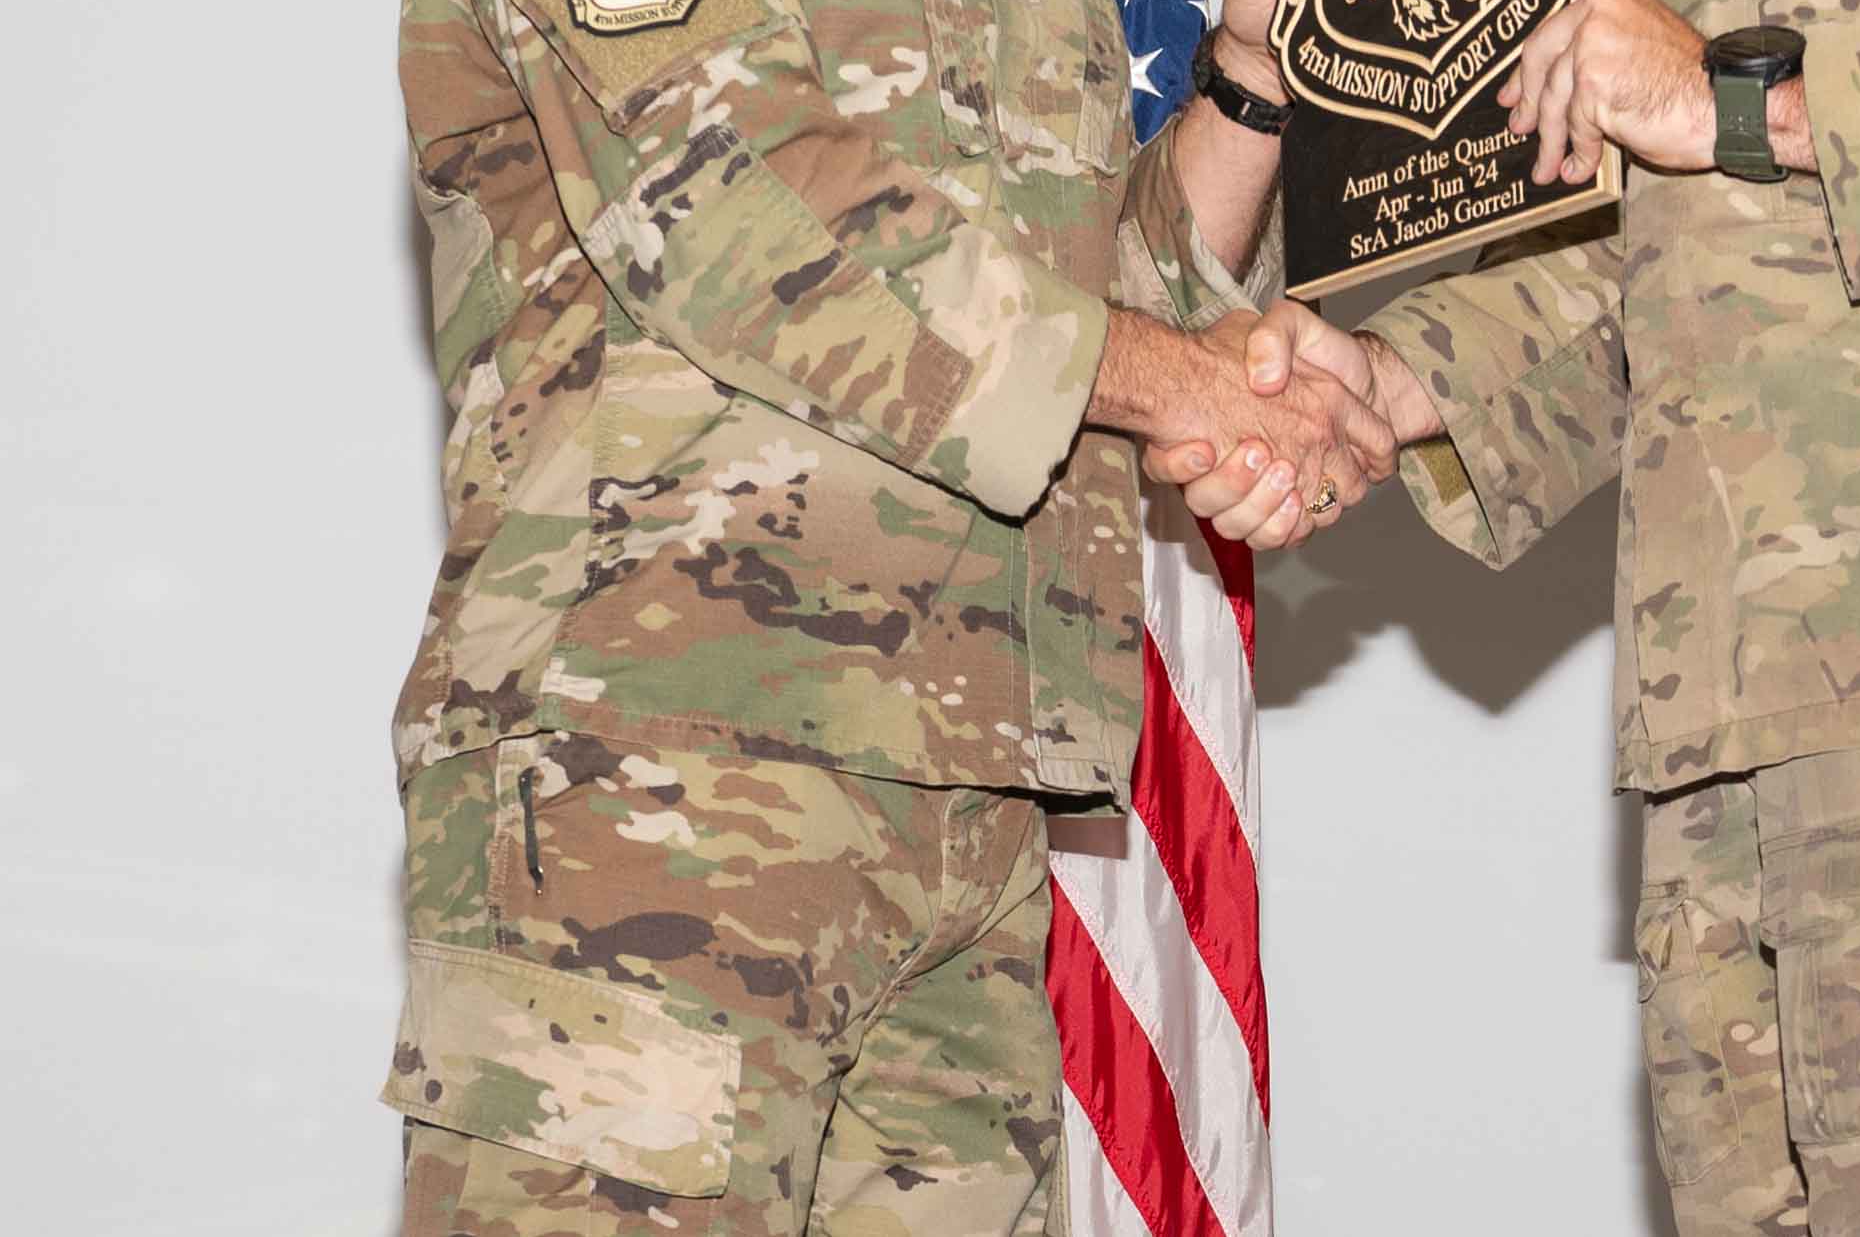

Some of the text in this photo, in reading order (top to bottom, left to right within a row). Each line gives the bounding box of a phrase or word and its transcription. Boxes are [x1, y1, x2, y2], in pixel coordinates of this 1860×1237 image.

[614, 9, 660, 25] MISSION
[1298, 35, 1331, 81] 4TH
[1326, 53, 1411, 108] MISSION
[1410, 25, 1497, 115] SUPPORT
[1342, 170, 1389, 203] Amn
[1393, 154, 1417, 185] of
[1419, 149, 1449, 177] the
[1374, 194, 1412, 223] Apr
[1430, 176, 1464, 203] Jun
[1469, 158, 1499, 189] '24
[1350, 179, 1526, 259] SrA Jacob Gorrell
